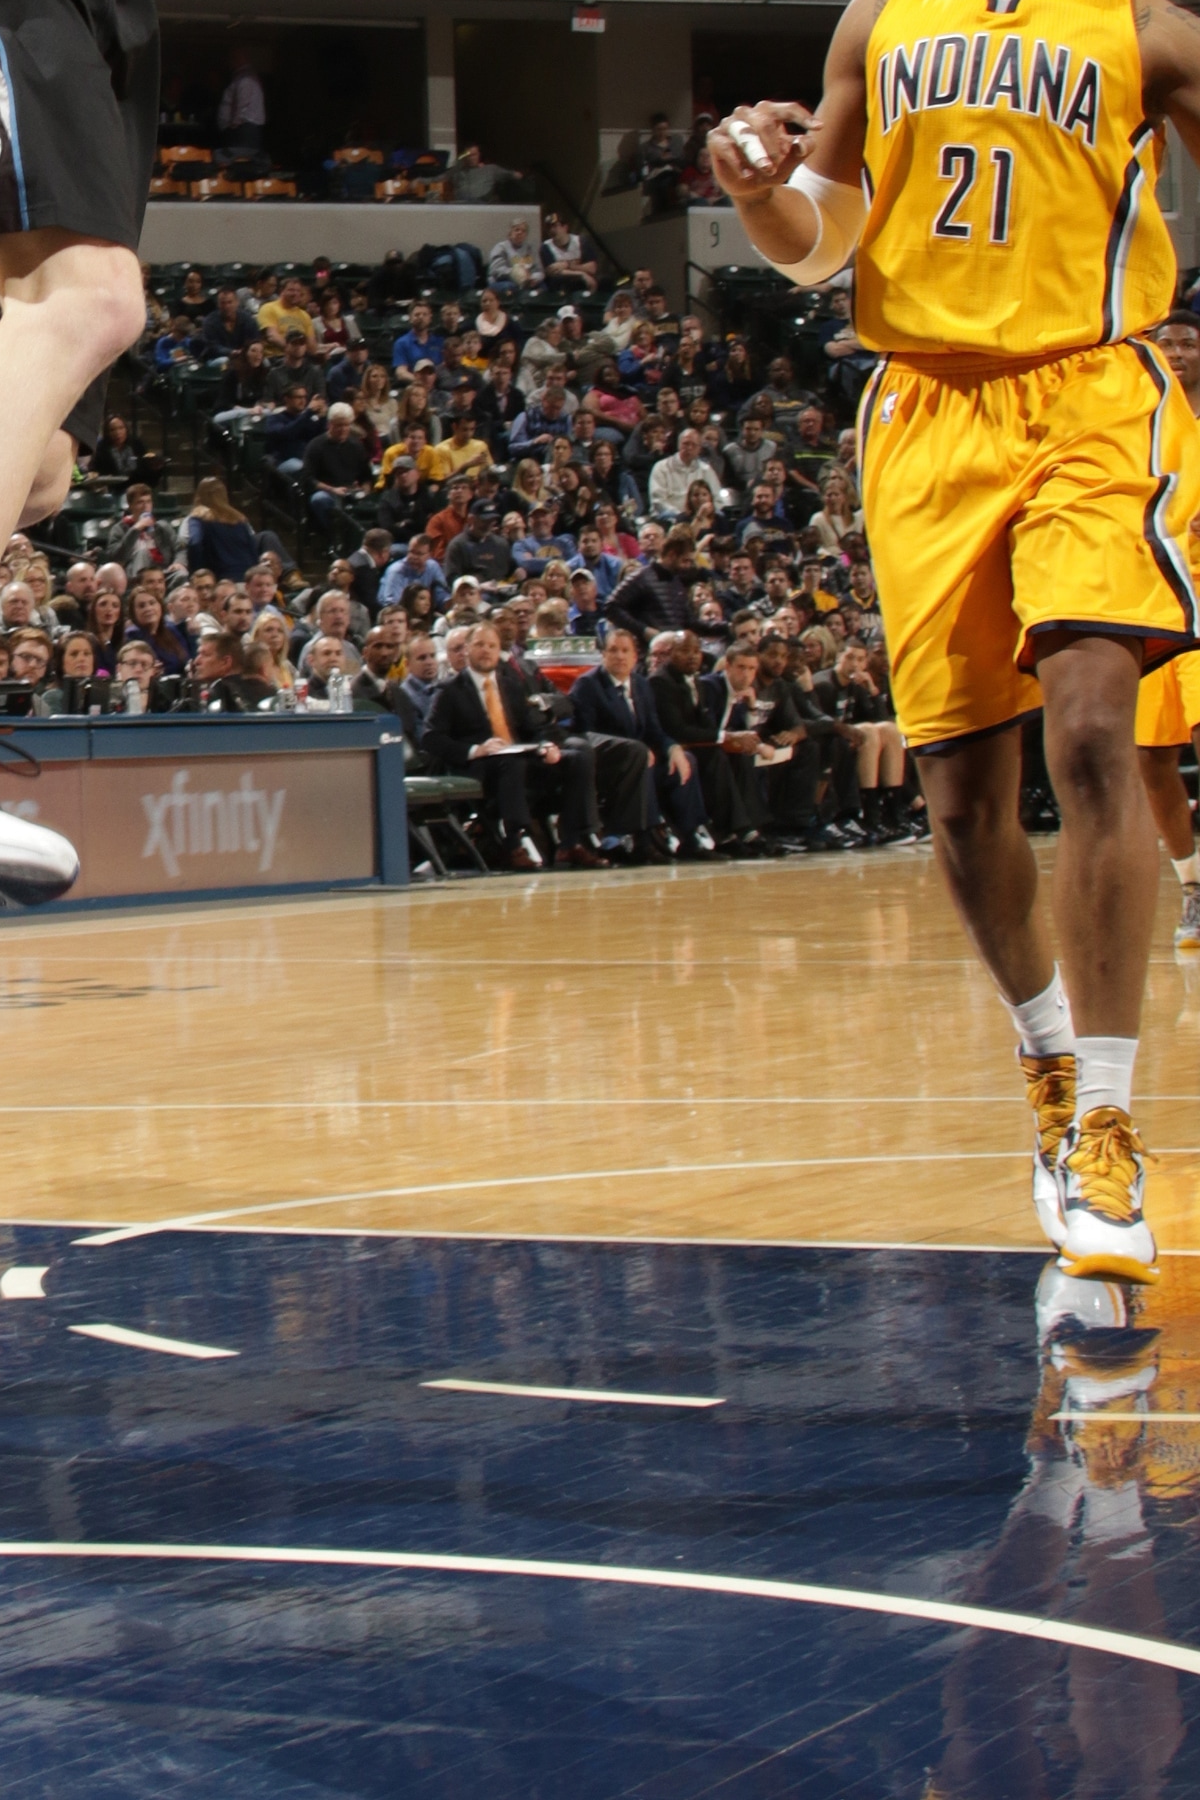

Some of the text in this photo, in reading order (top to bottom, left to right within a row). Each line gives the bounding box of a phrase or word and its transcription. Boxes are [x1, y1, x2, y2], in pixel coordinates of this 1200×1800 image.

[879, 32, 1101, 149] INDIANA
[709, 221, 720, 249] 9
[932, 143, 1016, 245] 21
[140, 768, 287, 877] xfinity
